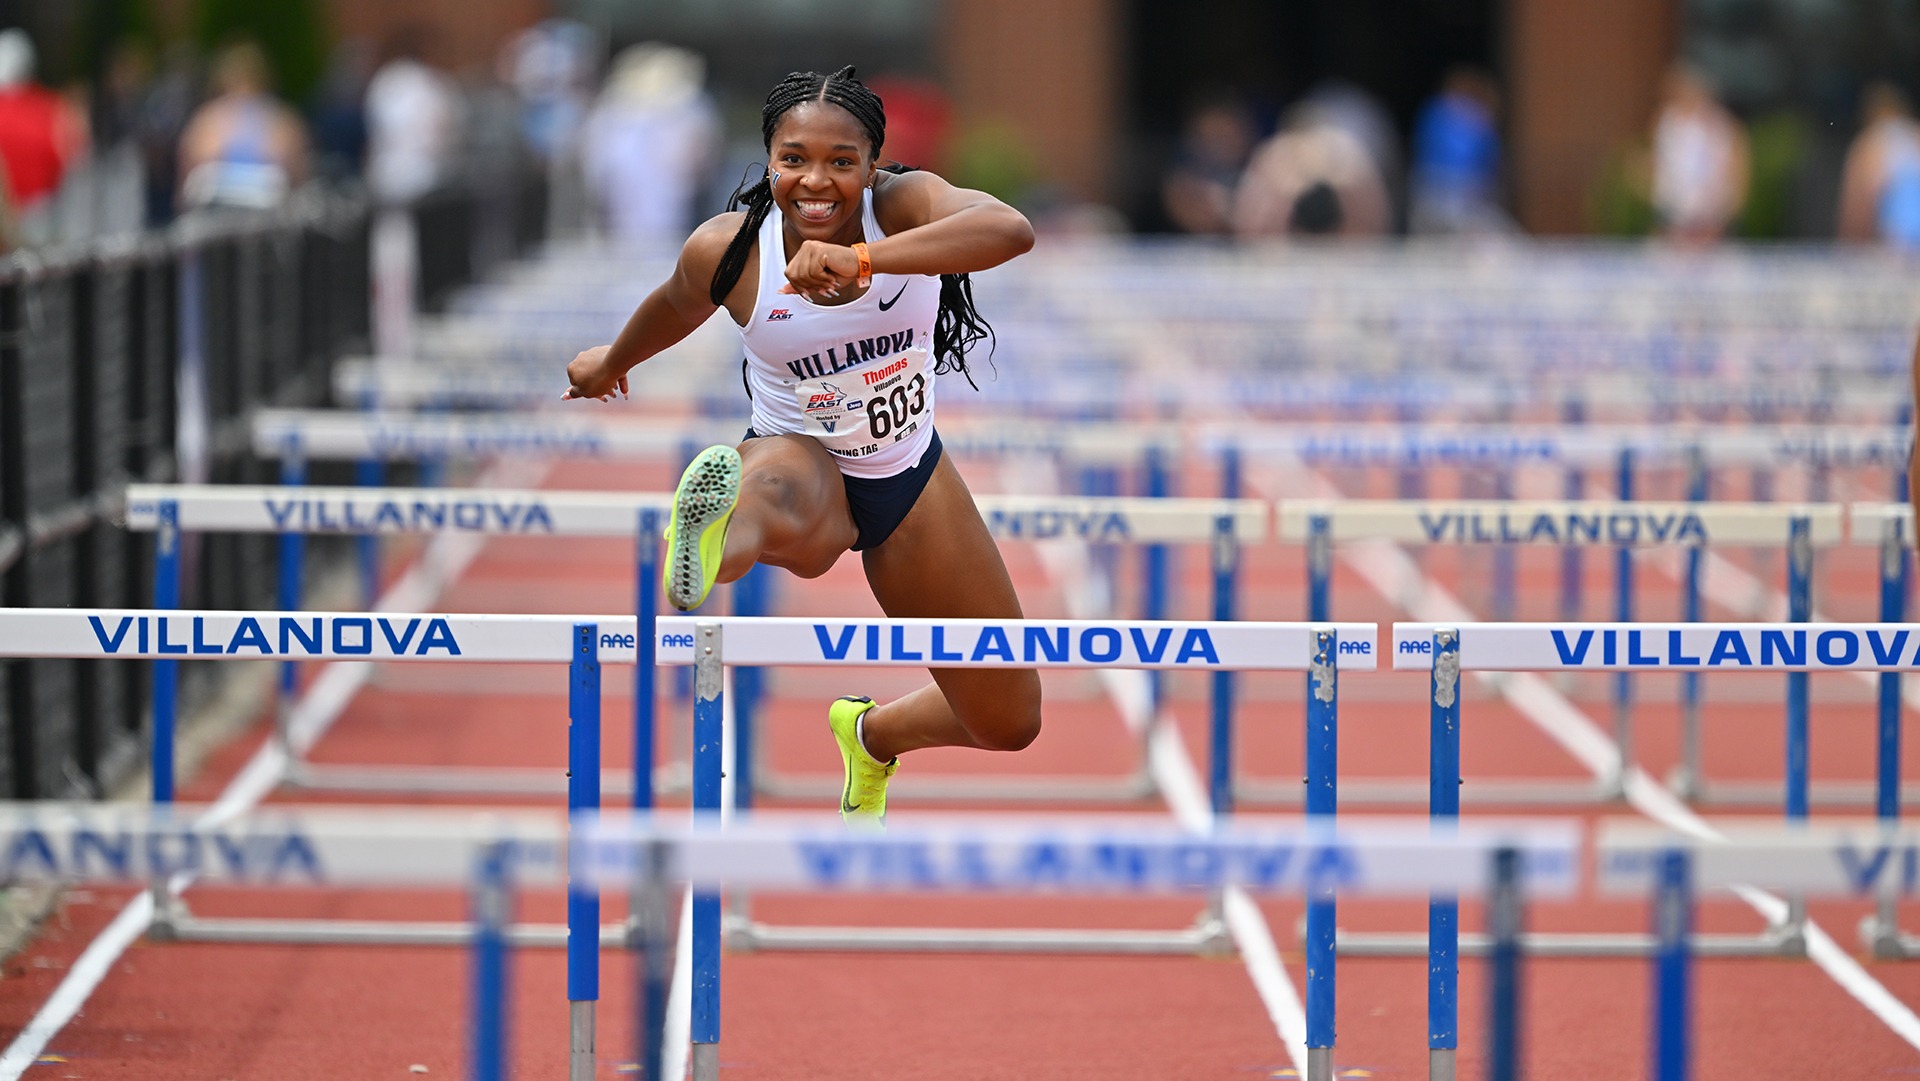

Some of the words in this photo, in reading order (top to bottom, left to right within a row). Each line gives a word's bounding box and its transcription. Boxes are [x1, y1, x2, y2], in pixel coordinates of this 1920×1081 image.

[787, 328, 914, 381] VILLANOVA
[862, 357, 908, 385] Thomas
[874, 374, 902, 393] Villanova
[807, 399, 843, 409] EAST
[810, 392, 835, 402] BIG
[848, 402, 862, 410] Jeep
[866, 372, 925, 439] 603
[826, 447, 859, 457] MING
[860, 443, 878, 456] TAG
[264, 499, 554, 532] VILLANOVA
[1418, 513, 1708, 544] VILLANOVA
[87, 615, 462, 656] VILLANOVA
[813, 624, 1220, 664] VILLANOVA
[1550, 630, 1920, 666] VILLANOV
